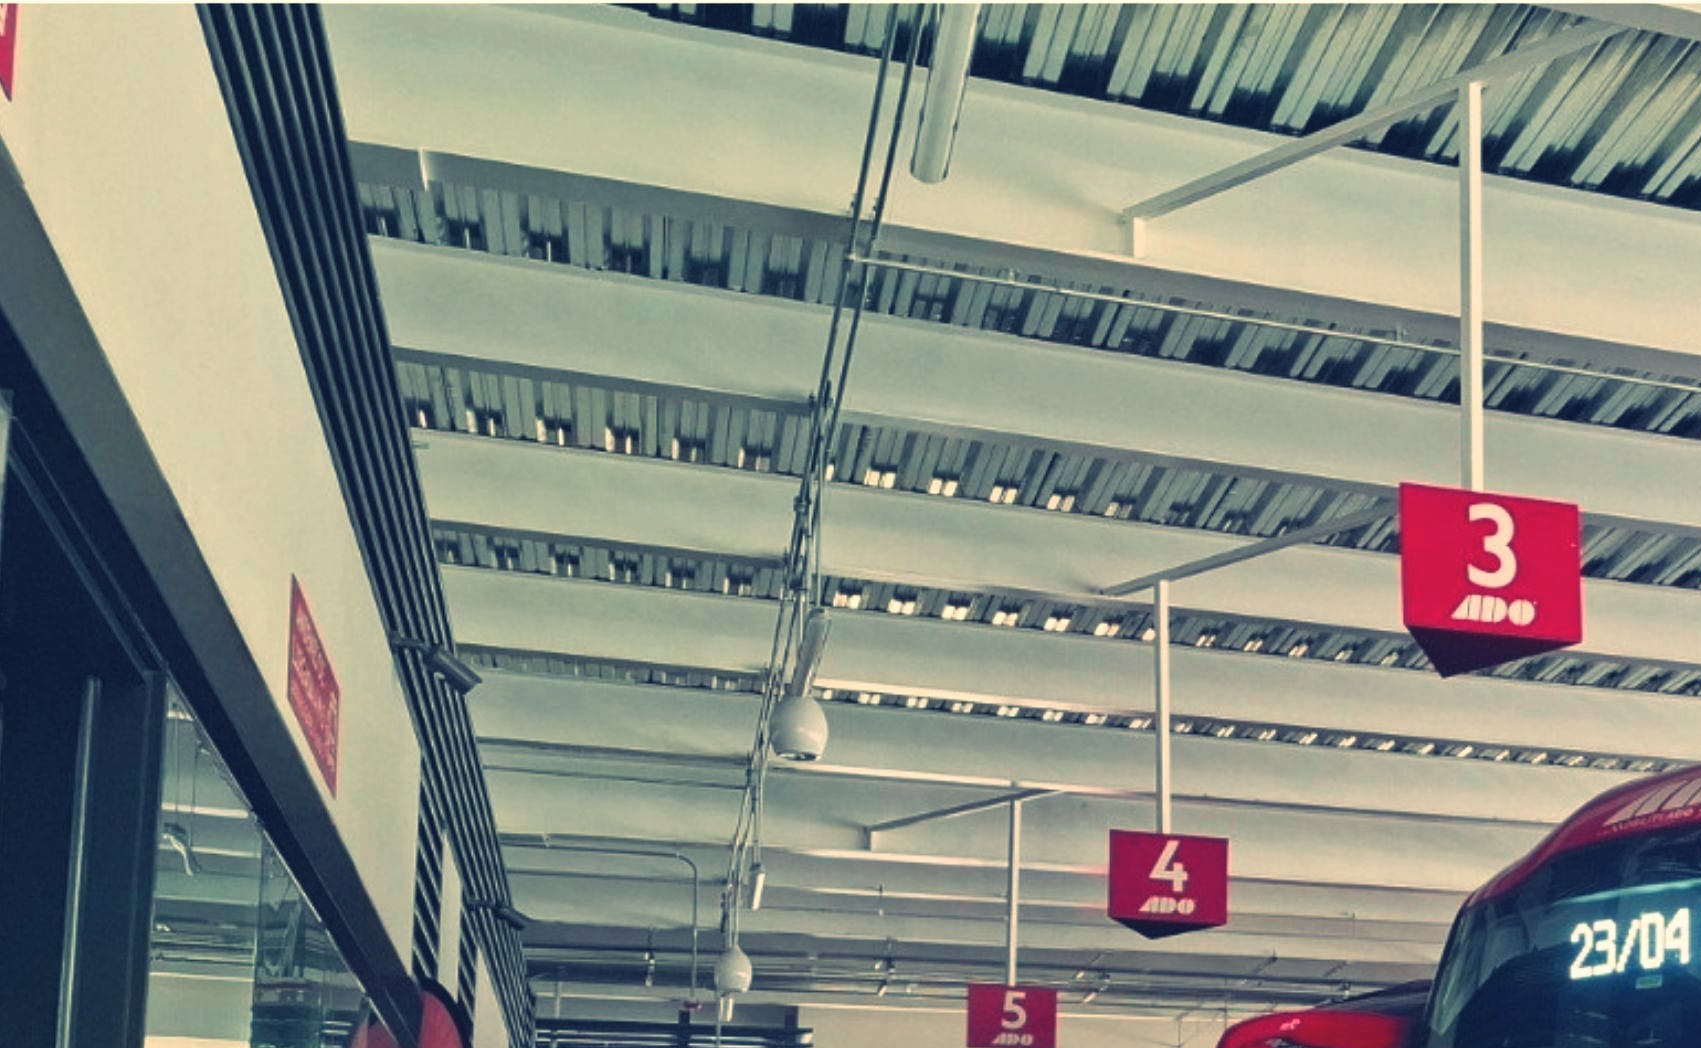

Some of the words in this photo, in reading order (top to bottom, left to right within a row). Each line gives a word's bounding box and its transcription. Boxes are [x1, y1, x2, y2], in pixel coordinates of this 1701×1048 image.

[1467, 503, 1518, 588] 3
[1450, 594, 1536, 627] ADO
[1149, 840, 1189, 893] 4
[1138, 896, 1196, 916] ADO
[1569, 907, 1690, 980] 23/04
[1000, 990, 1027, 1029] 5
[991, 1033, 1034, 1047] ADO
